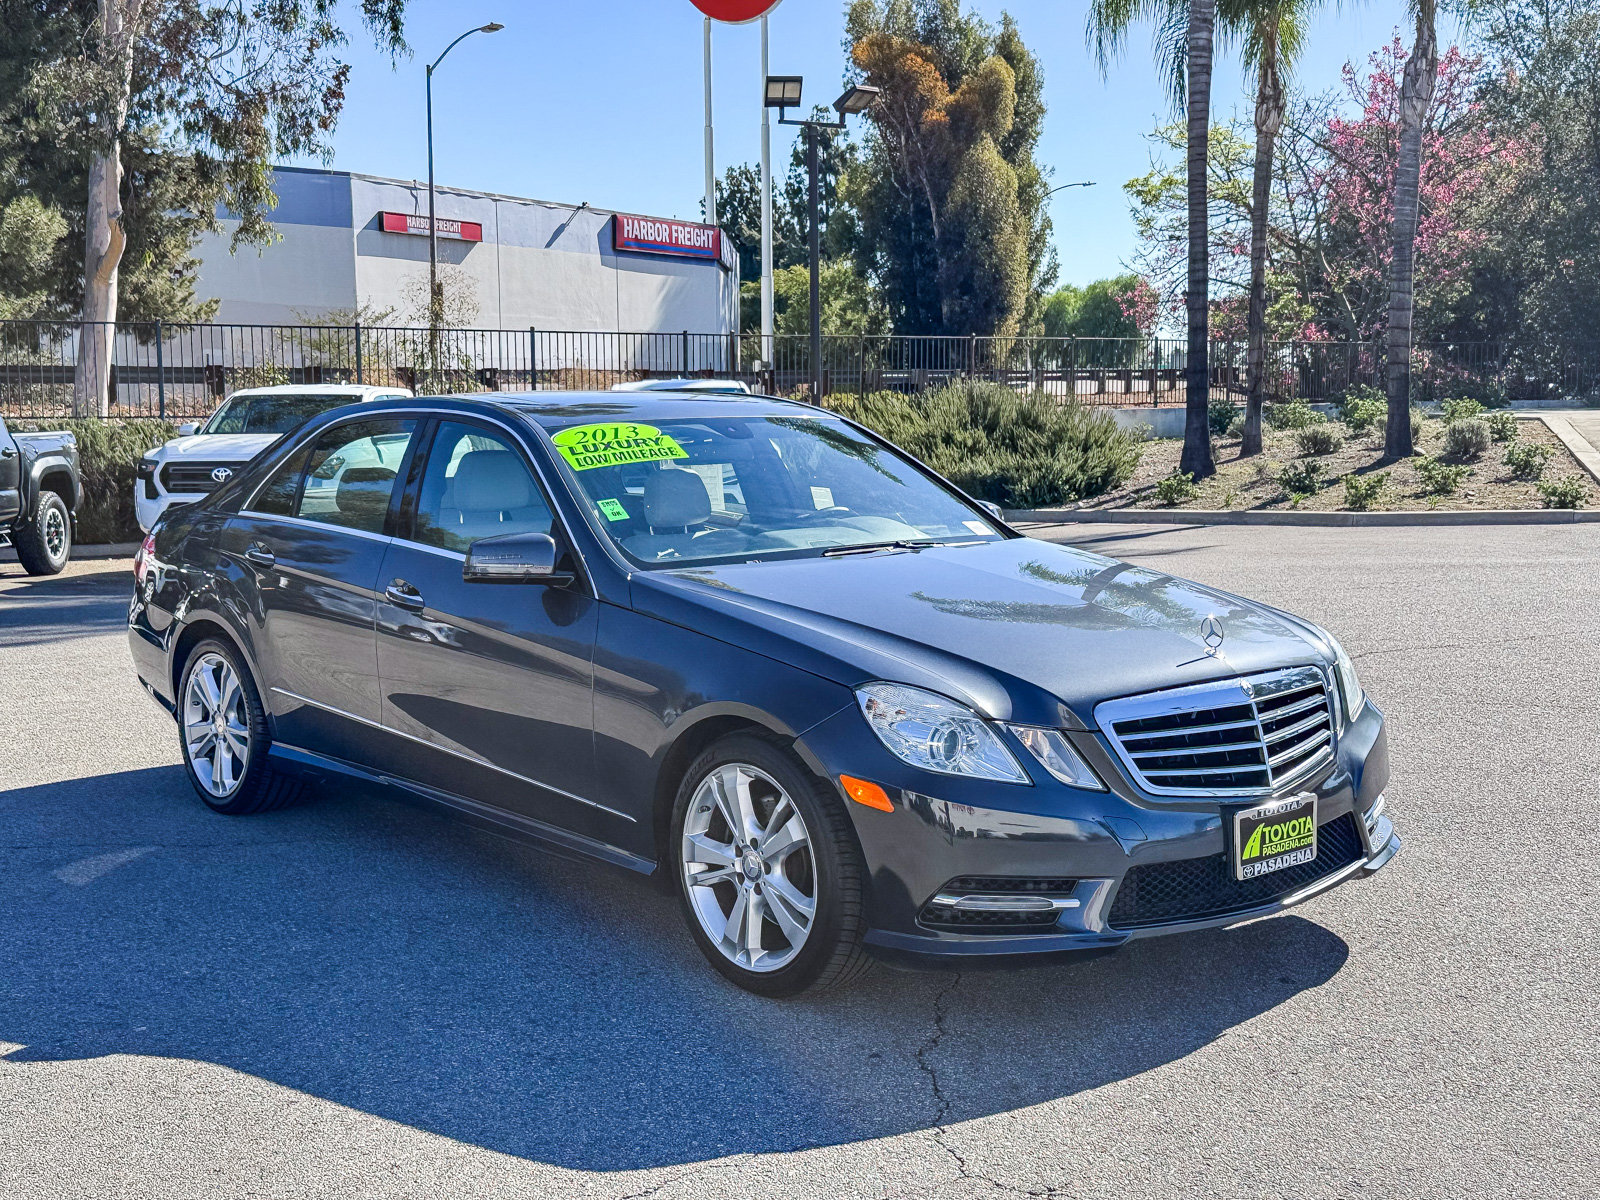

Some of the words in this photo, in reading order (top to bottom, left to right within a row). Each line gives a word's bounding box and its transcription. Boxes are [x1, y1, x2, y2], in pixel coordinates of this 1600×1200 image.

[407, 215, 430, 229] HARBO
[623, 218, 670, 243] HARBOR
[671, 225, 714, 248] FREIGHT
[574, 426, 640, 445] 2013
[568, 437, 663, 455] LUXURY
[575, 454, 609, 467] LOW
[613, 447, 678, 461] MILEAGE
[1260, 801, 1298, 817] TOYOTA
[1263, 816, 1313, 844] TOYOTA
[1263, 837, 1313, 856] PASADENA.com
[1255, 849, 1312, 876] PASADENA
